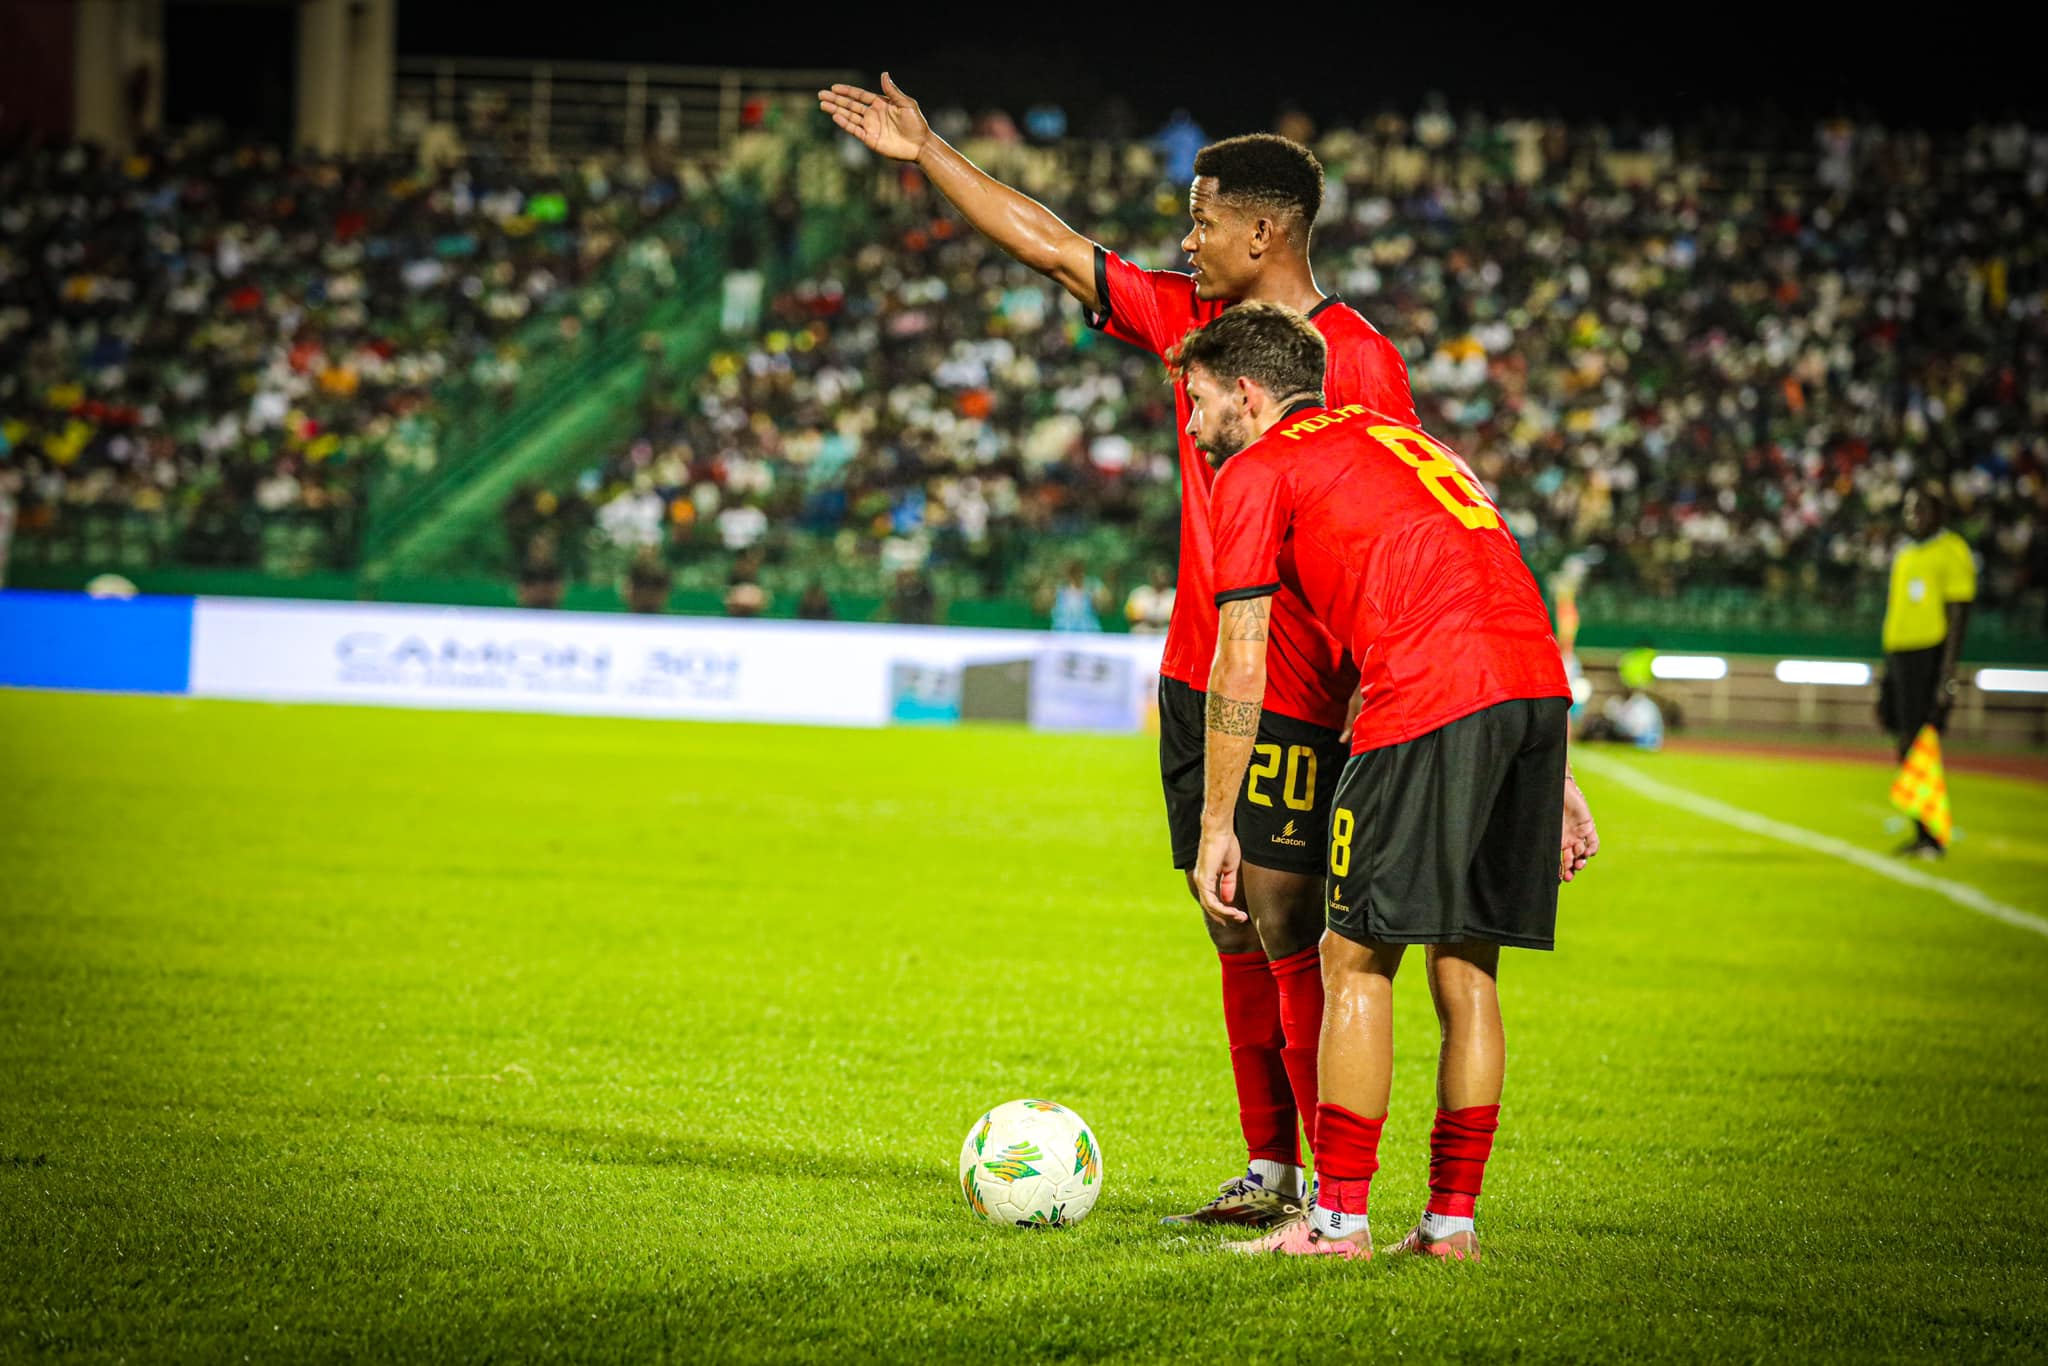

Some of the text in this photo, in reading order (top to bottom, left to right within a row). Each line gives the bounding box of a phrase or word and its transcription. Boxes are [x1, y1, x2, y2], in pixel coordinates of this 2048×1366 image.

[1366, 424, 1500, 530] 8
[1247, 743, 1317, 811] 20
[1271, 834, 1306, 847] Lacatoni
[1330, 807, 1355, 877] 8
